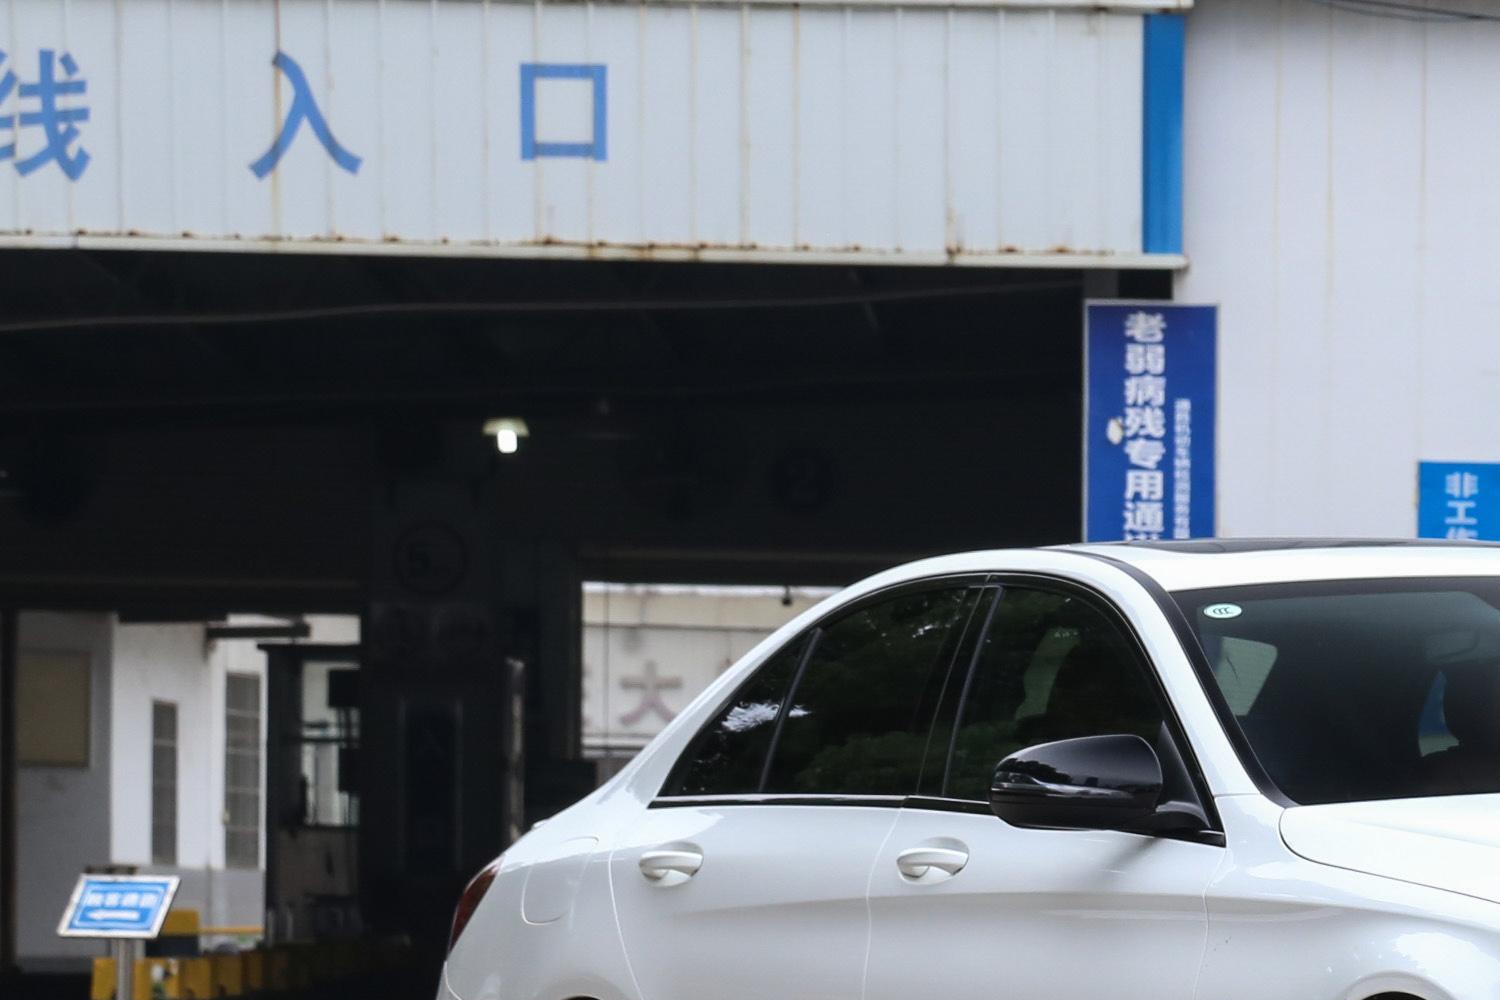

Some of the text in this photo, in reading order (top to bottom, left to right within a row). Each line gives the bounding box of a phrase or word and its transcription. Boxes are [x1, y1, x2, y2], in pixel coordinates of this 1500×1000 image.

[1124, 311, 1166, 540] 老弱病残专用通
